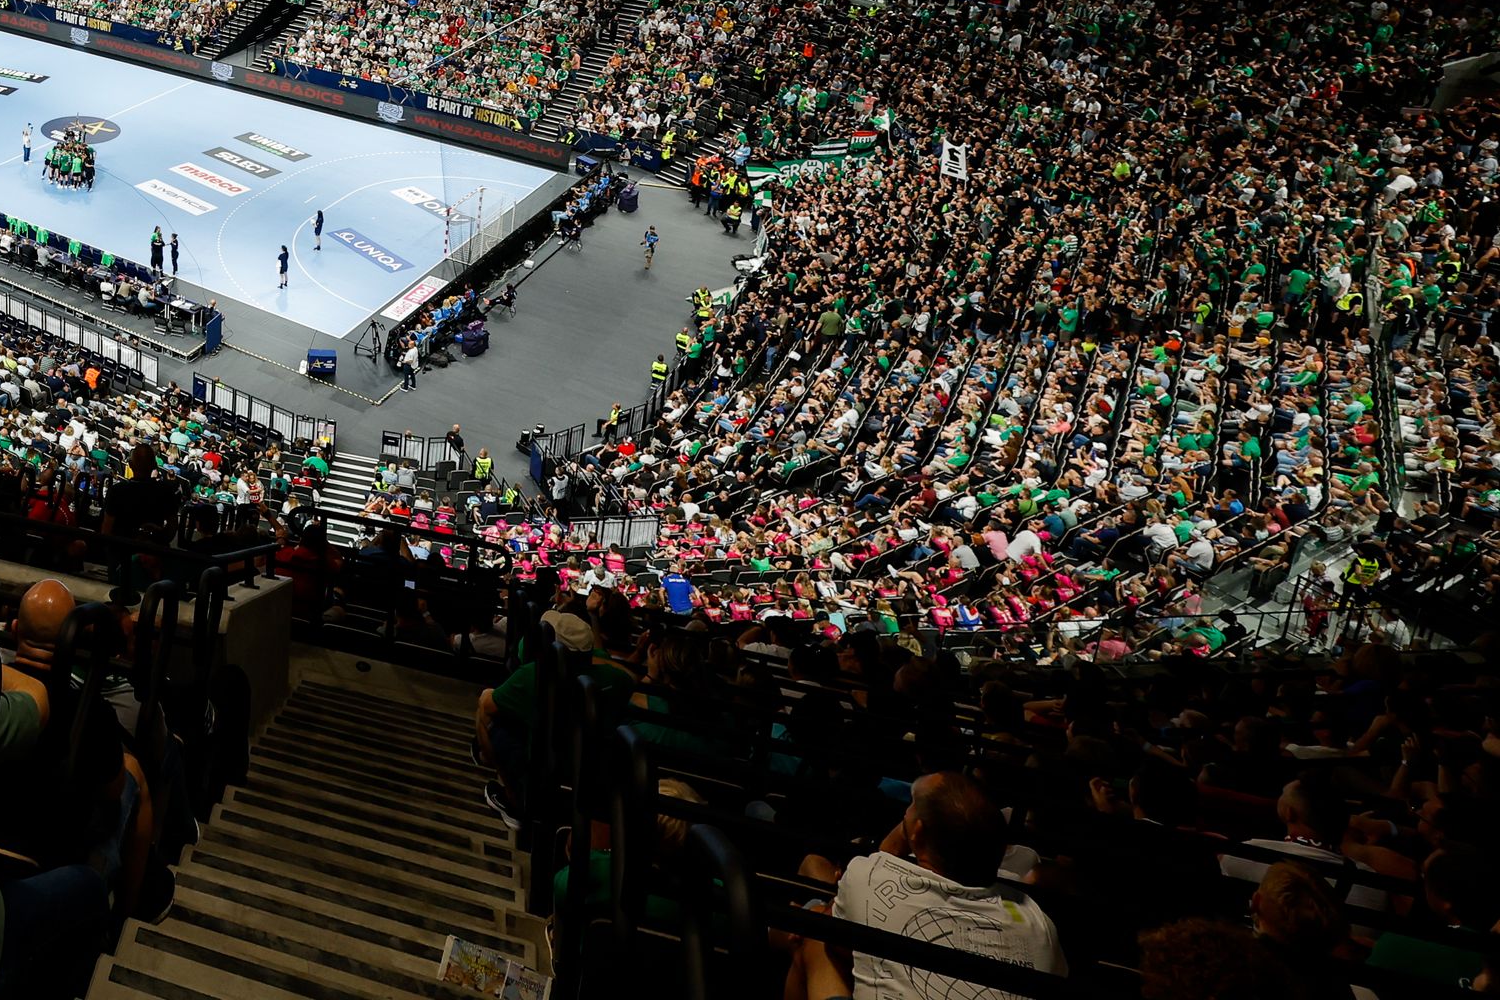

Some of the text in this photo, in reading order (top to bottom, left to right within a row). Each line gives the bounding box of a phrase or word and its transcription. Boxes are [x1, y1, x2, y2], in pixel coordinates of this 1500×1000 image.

[55, 9, 113, 33] BE PART OF HISTORY
[244, 72, 344, 105] SZABADICS
[427, 96, 512, 128] BE PART OF HISTORY
[248, 134, 305, 158] UNIBET
[414, 115, 563, 158] WWW.SZABADICS.HU
[214, 151, 270, 175] SELECT
[179, 165, 243, 194] mateco
[423, 201, 470, 222] OMV
[353, 240, 403, 271] UNIQA
